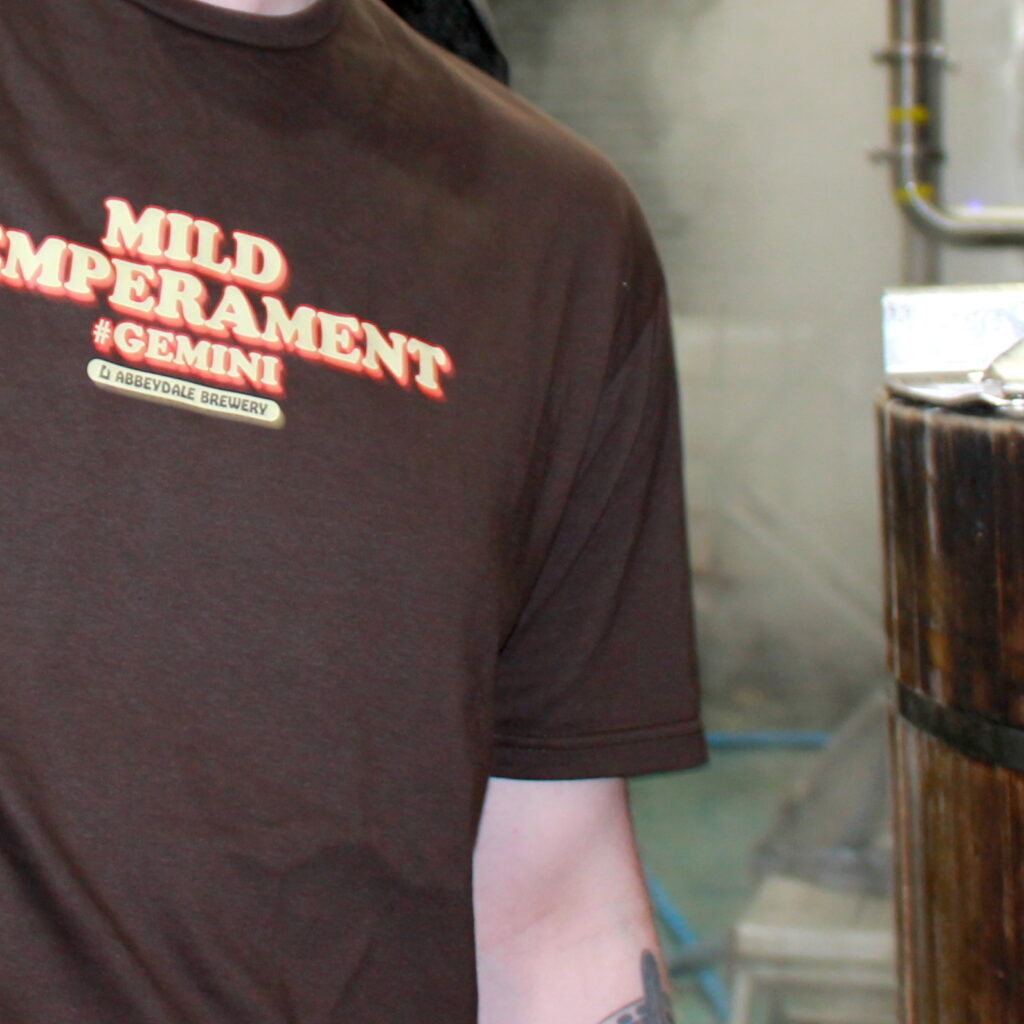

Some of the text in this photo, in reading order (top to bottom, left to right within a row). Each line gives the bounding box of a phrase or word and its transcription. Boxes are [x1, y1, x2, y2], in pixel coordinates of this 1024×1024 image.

[102, 196, 288, 293] MILD
[92, 317, 285, 395] #GEMINI
[115, 370, 268, 416] ABBEYDALE BREWERY
